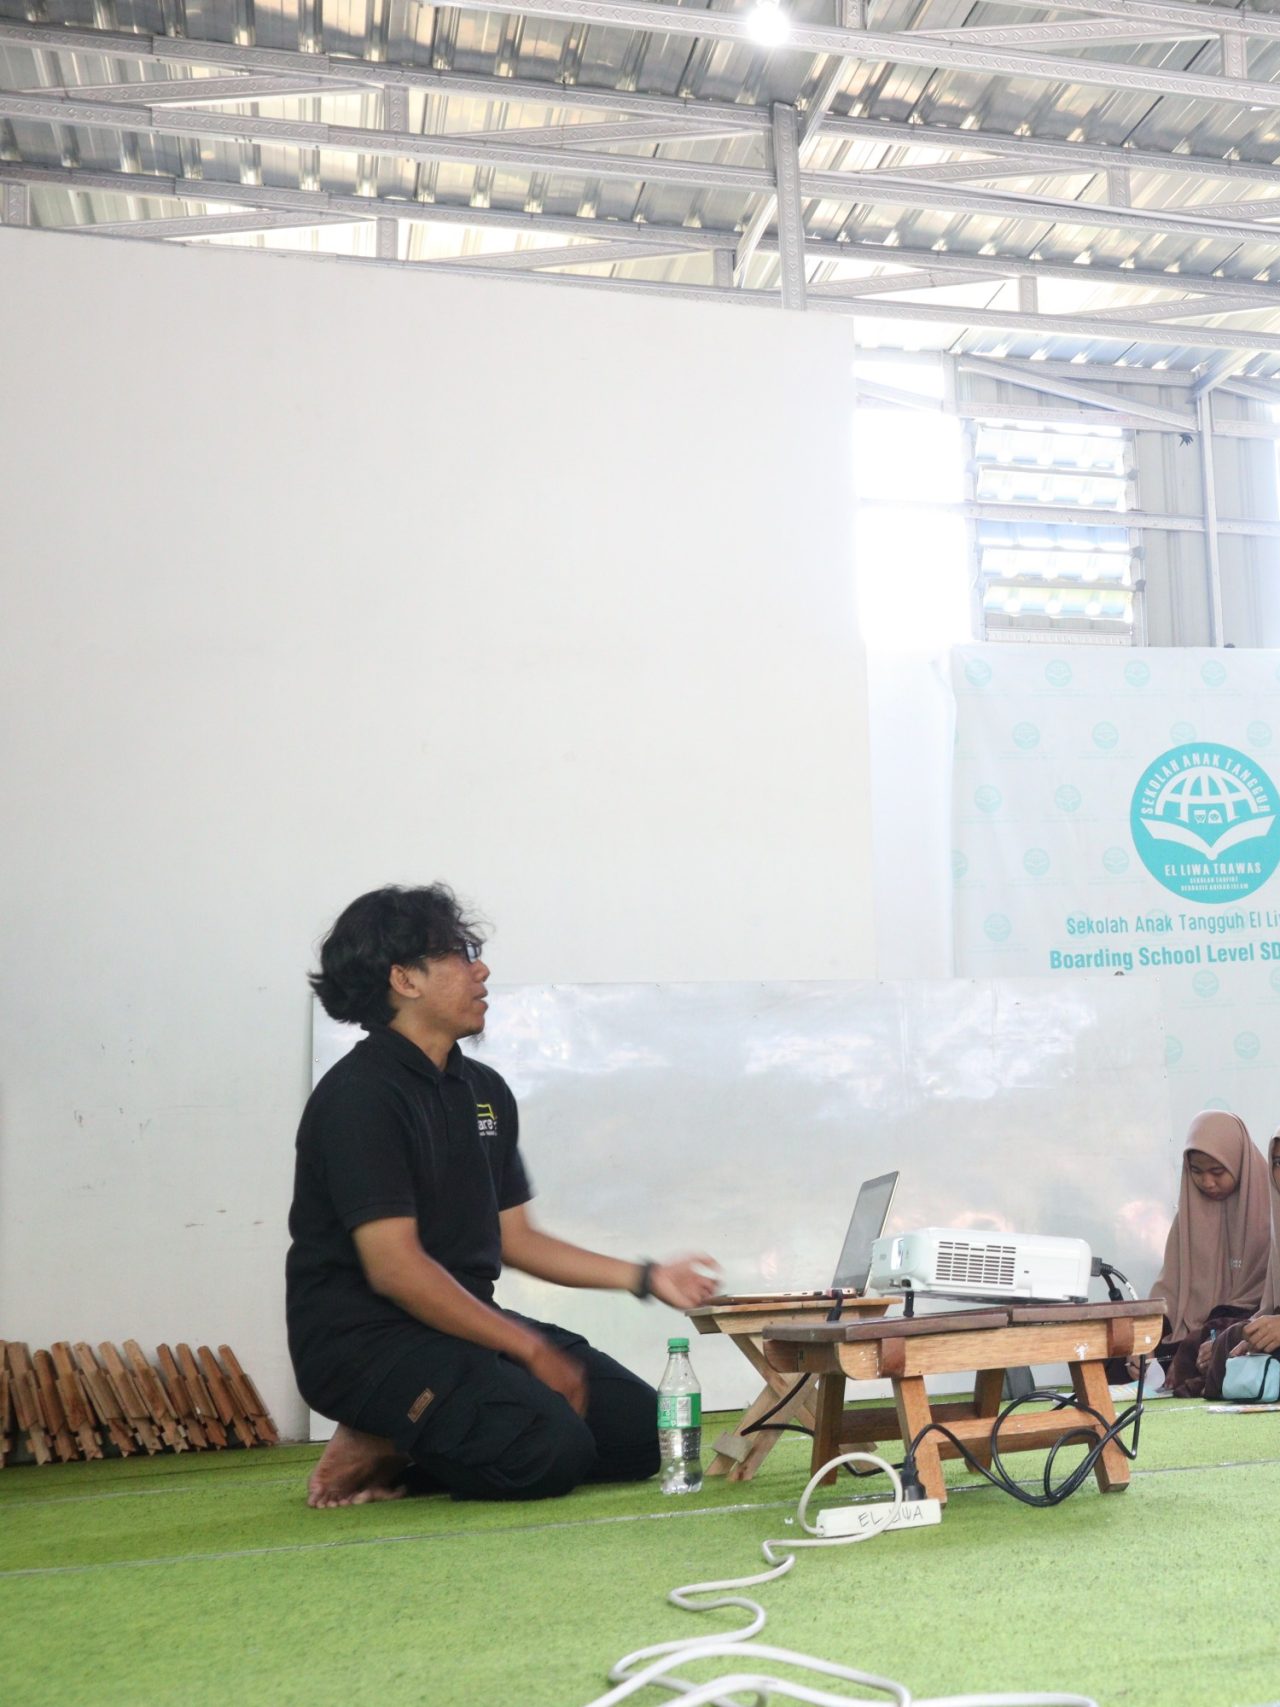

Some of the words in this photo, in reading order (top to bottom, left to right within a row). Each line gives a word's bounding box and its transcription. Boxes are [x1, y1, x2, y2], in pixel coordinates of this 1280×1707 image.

[1141, 759, 1180, 815] SEKOLAH
[1182, 752, 1221, 768] ANAK
[1225, 758, 1271, 812] TANGGUH
[1164, 864, 1177, 876] EL
[1180, 863, 1210, 876] LIWA
[1213, 862, 1262, 875] TRAWAS
[1066, 916, 1128, 935] Sekolah
[1135, 915, 1173, 932] Anak
[1179, 912, 1245, 934] Tangguh
[1249, 911, 1261, 928] El
[1050, 948, 1133, 971] Boarding
[1139, 944, 1201, 966] School
[1206, 942, 1254, 963] Level
[858, 1511, 884, 1527] EL
